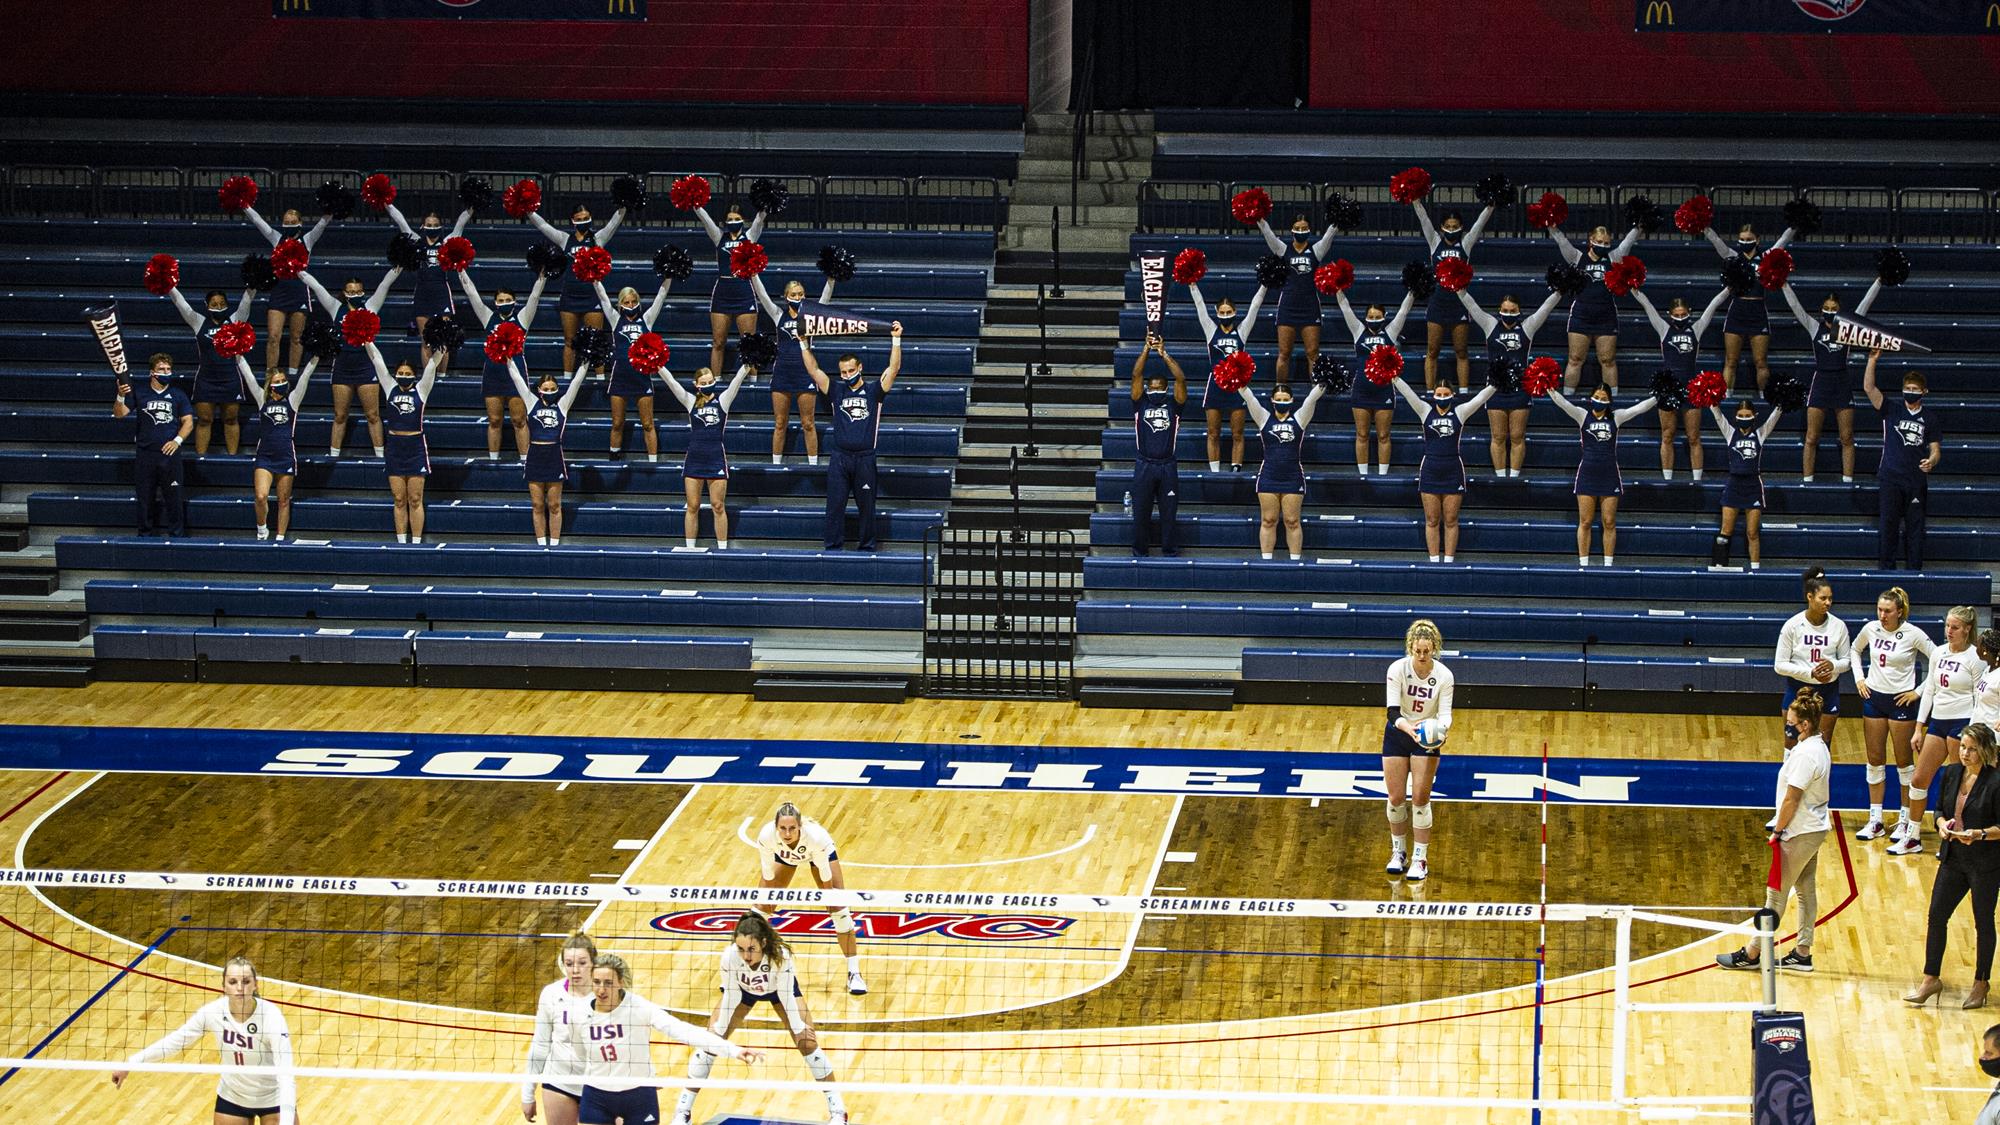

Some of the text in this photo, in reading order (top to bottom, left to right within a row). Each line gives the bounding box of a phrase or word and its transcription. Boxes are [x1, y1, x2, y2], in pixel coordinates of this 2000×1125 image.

[1291, 257, 1310, 265] USI
[1585, 264, 1605, 272] USI
[1141, 256, 1165, 322] EAGLES
[621, 325, 642, 333] USI
[804, 314, 868, 336] EAGLES
[1365, 337, 1385, 345] USI
[1499, 333, 1519, 341] USI
[1672, 335, 1692, 343] USI
[1836, 320, 1902, 351] EAGLES
[91, 313, 128, 374] EAGLES
[1217, 339, 1238, 347] USI
[394, 395, 414, 404] USI
[842, 399, 867, 408] USI
[148, 401, 172, 412] USI
[266, 406, 287, 414] USI
[697, 408, 718, 416] USI
[537, 409, 558, 418] USI
[1145, 409, 1169, 418] USI
[1272, 424, 1293, 432] USI
[1432, 418, 1453, 426] USI
[1590, 422, 1611, 431] USI
[1900, 420, 1925, 432] USI
[1736, 441, 1756, 449] USI
[1804, 634, 1829, 647] USI
[1874, 638, 1897, 652] USI
[1810, 648, 1821, 663] 10
[1879, 653, 1886, 668] 9
[1938, 659, 1961, 673] USI
[1940, 673, 1950, 688] 16
[1407, 684, 1433, 699] USI
[1411, 700, 1425, 713] 15
[260, 748, 1640, 801] SOUTHERN
[72, 873, 126, 884] EAGLES
[206, 876, 357, 891] SCREAMING EAGLES
[437, 882, 589, 896] SCREAMING EAGLES
[670, 887, 823, 902] SCREAMING EAGLES
[904, 893, 1058, 907] SCREAMING EAGLES
[1140, 898, 1295, 912] SCREAMING EAGLES
[1376, 903, 1533, 917] SCREAMING EAGLES
[741, 972, 768, 986] USI
[223, 1028, 253, 1050] USI
[589, 1024, 624, 1041] USI
[600, 1043, 618, 1062] 13
